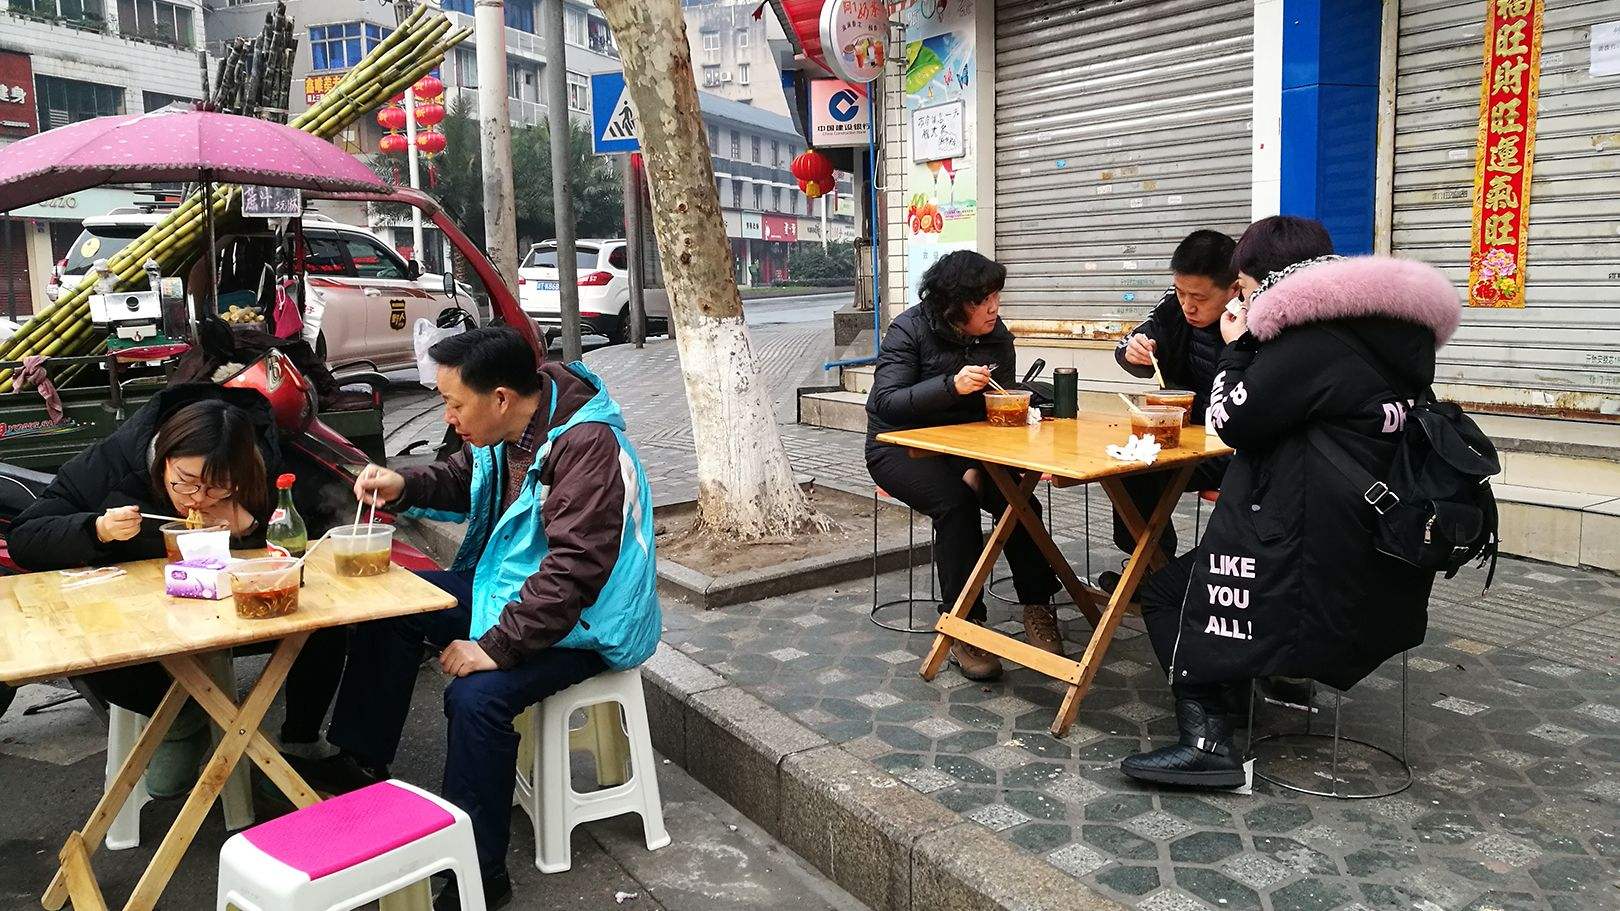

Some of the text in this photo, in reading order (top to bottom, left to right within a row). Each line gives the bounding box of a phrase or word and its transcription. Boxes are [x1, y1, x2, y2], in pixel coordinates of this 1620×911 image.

[1209, 553, 1256, 579] LIKE
[1207, 584, 1250, 609] YOU
[1204, 615, 1253, 640] ALL!
